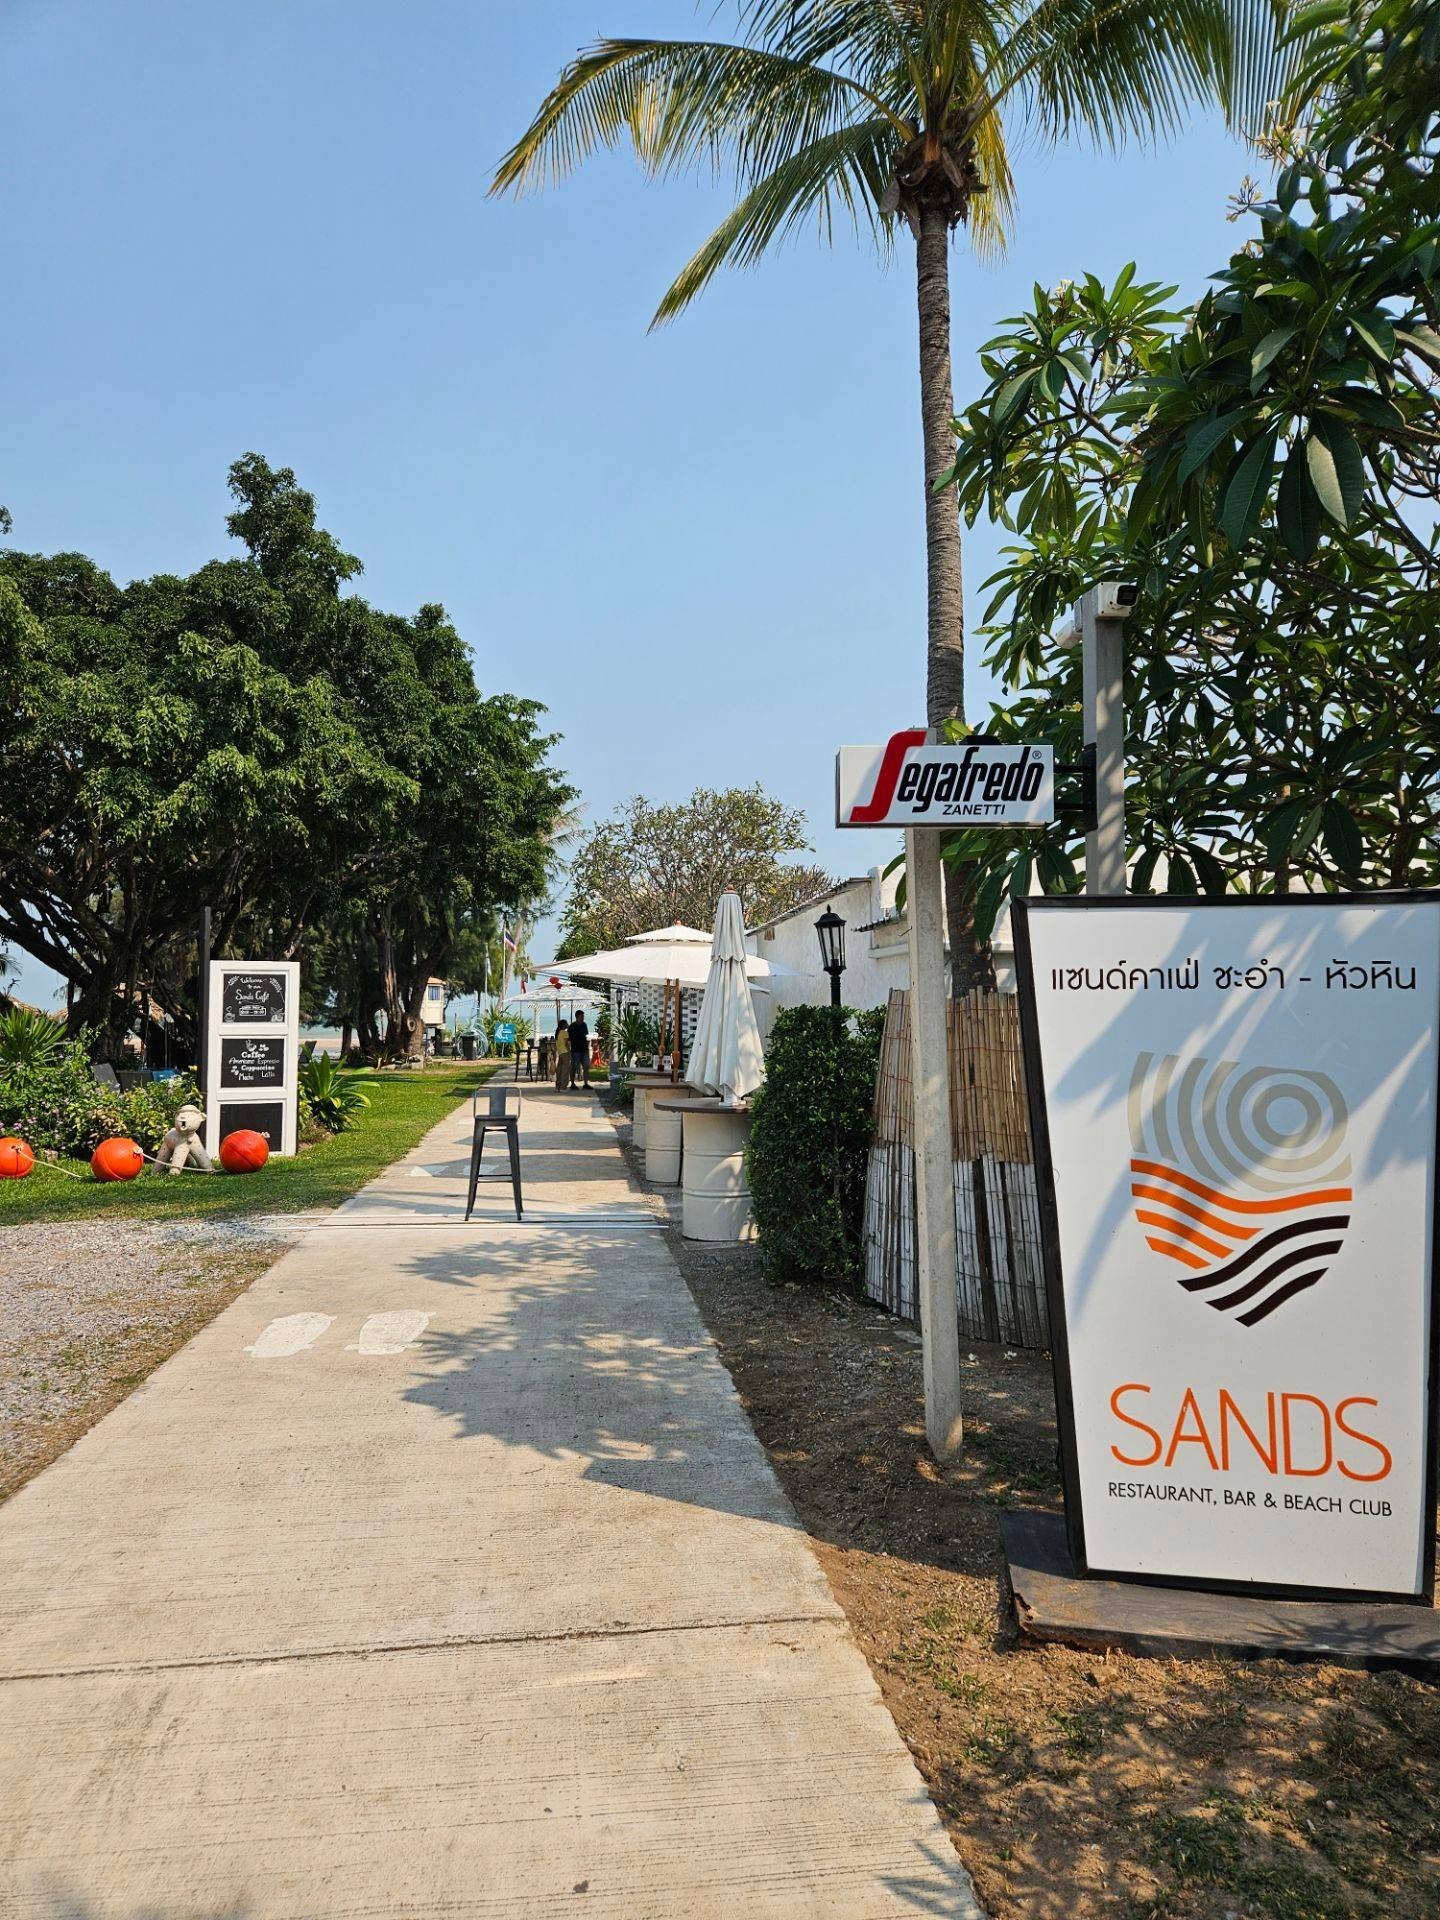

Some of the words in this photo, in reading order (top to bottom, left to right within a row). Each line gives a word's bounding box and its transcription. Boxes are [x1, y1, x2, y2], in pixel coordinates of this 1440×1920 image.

[849, 730, 1045, 823] Segafredo
[942, 804, 1005, 816] ZANETTI
[1052, 957, 1200, 990] แซนด์คาเฟ่
[1213, 958, 1285, 990] ชะอำ
[1326, 958, 1416, 990] หัวหิน
[241, 1051, 266, 1059] Coffee
[1109, 1383, 1393, 1482] SANDS
[1108, 1482, 1217, 1506] RESTAURANT,
[1223, 1490, 1256, 1507] BAR
[1263, 1493, 1278, 1509] &
[1284, 1494, 1342, 1513] BEACH
[1349, 1499, 1393, 1517] CLUB
